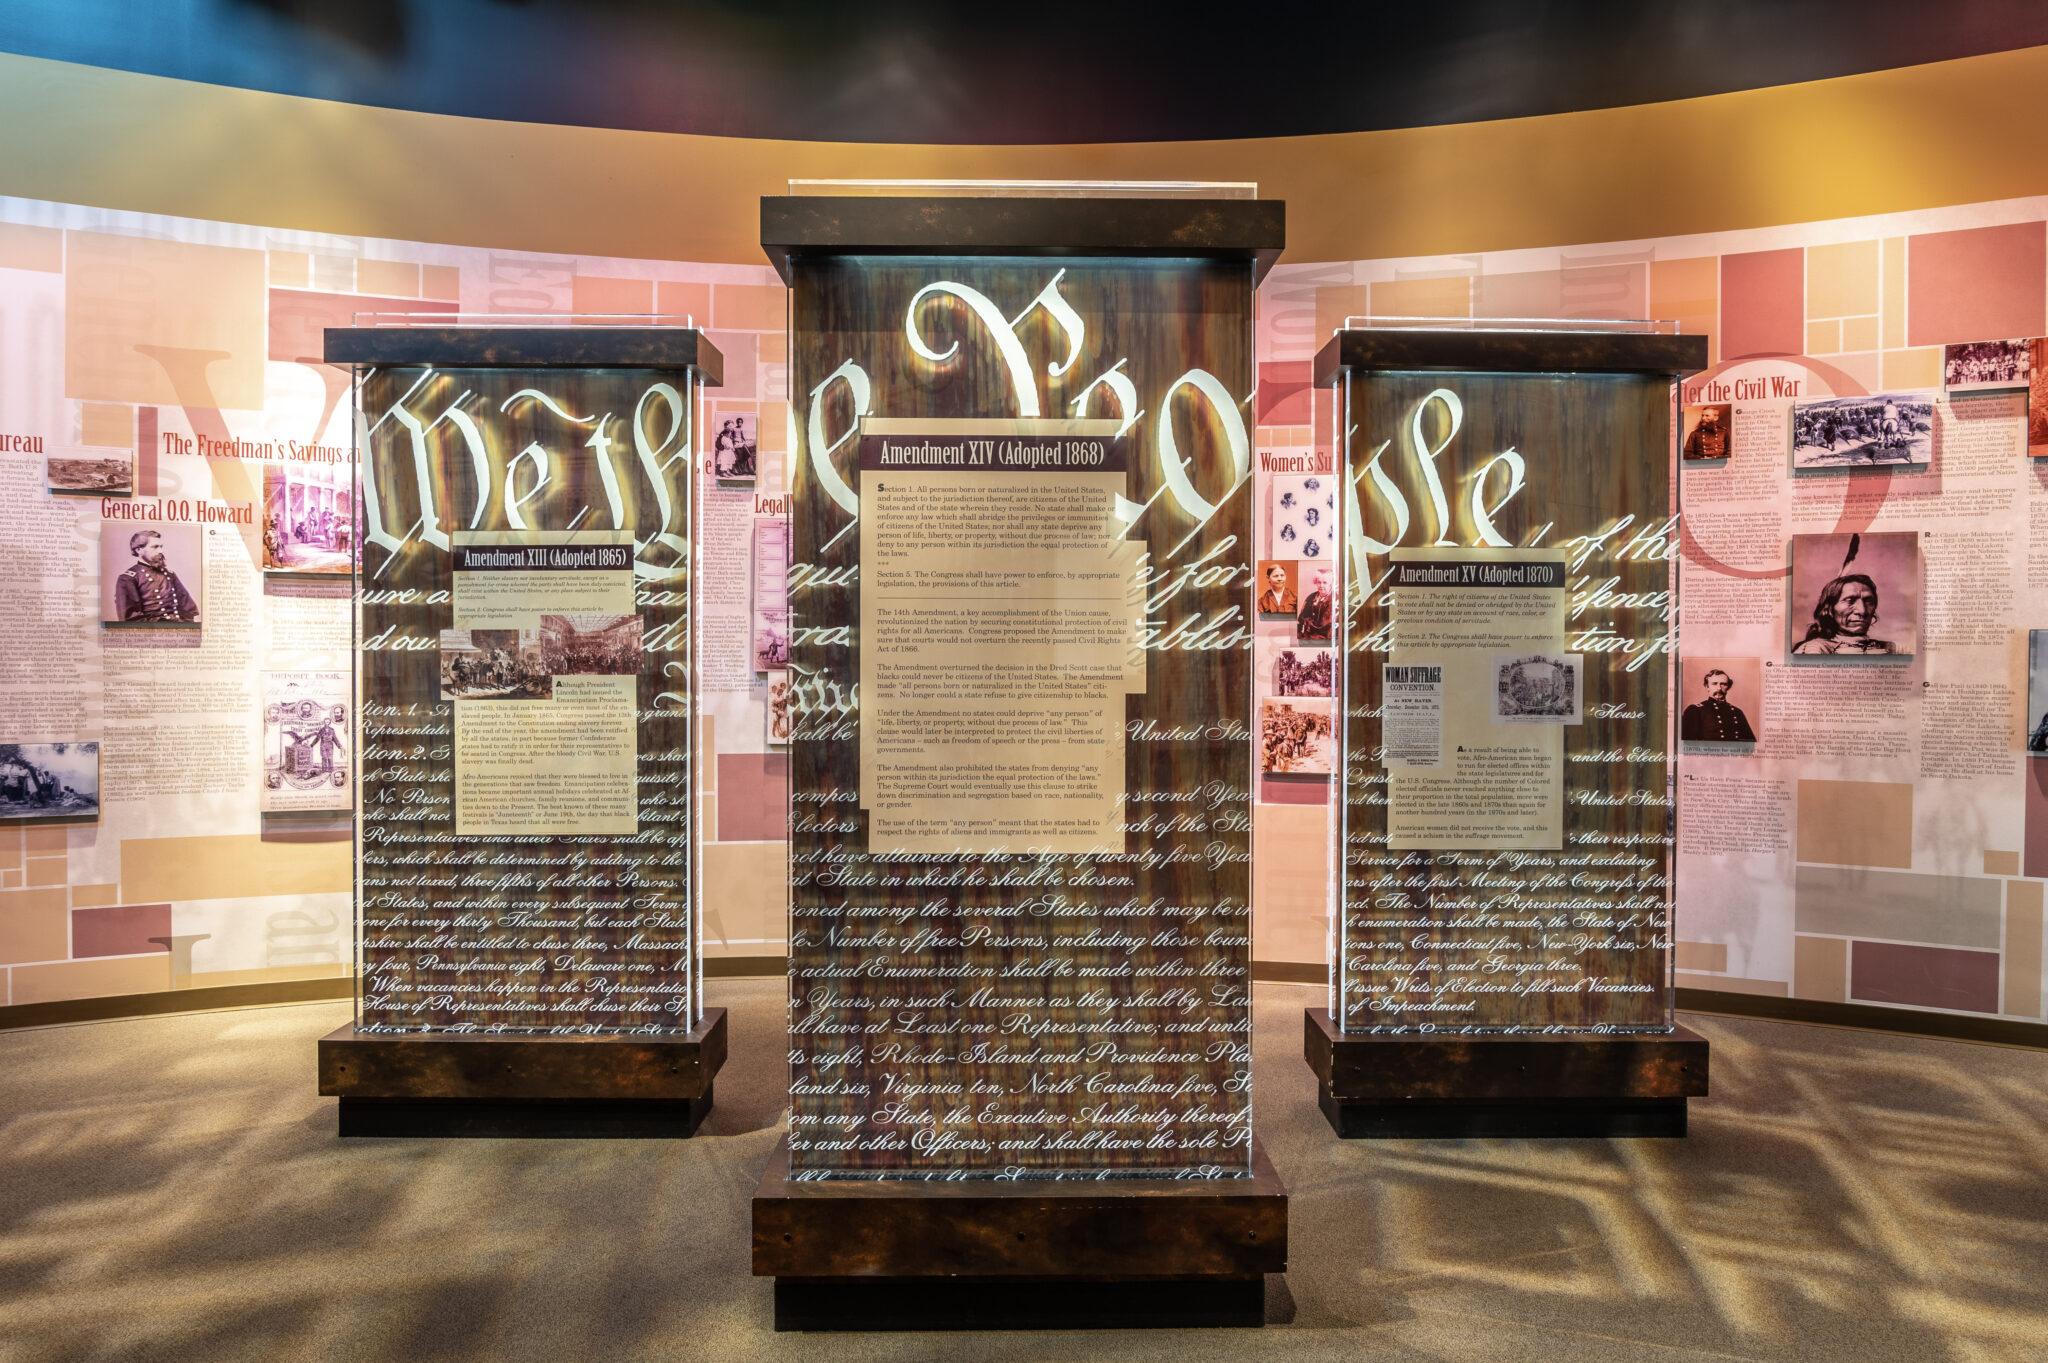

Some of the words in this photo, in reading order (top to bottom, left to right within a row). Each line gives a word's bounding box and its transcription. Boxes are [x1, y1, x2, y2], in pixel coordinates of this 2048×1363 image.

[1708, 381, 1730, 401] the
[1735, 377, 1766, 400] Civil
[1771, 376, 1800, 398] War
[163, 432, 193, 455] The
[198, 433, 285, 459] Freedman's
[289, 439, 342, 464] Savings
[880, 441, 965, 464] Amendment
[968, 441, 995, 464] XIV
[999, 441, 1062, 468] (Adopted
[1065, 441, 1104, 465] 1868)
[1260, 452, 1314, 472] Women's
[878, 484, 906, 493] Section
[102, 497, 162, 520] General
[168, 501, 192, 522] O.O.
[196, 501, 252, 524] Howard
[755, 494, 787, 516] Legal
[464, 549, 525, 567] Amendment
[527, 549, 547, 566] XIII
[550, 549, 596, 568] (Adopted
[598, 549, 626, 566] 1865)
[931, 571, 963, 580] Congress
[1068, 572, 1076, 580] by
[1078, 572, 1120, 580] appropriate
[932, 580, 969, 589] provisions
[1400, 565, 1459, 583] Amendment
[1461, 566, 1476, 583] XV
[1479, 566, 1524, 585] (Adopted
[1526, 566, 1553, 583] 1870)
[967, 608, 979, 617] key
[982, 609, 1039, 617] accomplishment
[1385, 667, 1408, 683] WOMAN
[1410, 667, 1441, 683] SUFFRAGE
[1125, 720, 1200, 741] United
[816, 863, 878, 886] State
[880, 872, 903, 886] in
[906, 867, 967, 886] which
[961, 866, 987, 886] he
[989, 862, 1046, 886] shall
[1044, 867, 1065, 886] be
[416, 954, 508, 976] Pennsylvania
[554, 954, 626, 972] Delaware
[1347, 955, 1414, 971] Carolina
[1447, 959, 1480, 971] and
[1482, 954, 1544, 976] Georgia
[1354, 983, 1389, 993] issue
[1391, 977, 1432, 993] Writs
[1434, 979, 1455, 997] of
[1451, 977, 1507, 993] Election
[1510, 982, 1525, 993] to
[1521, 978, 1553, 997] fill
[1550, 978, 1585, 993] such
[363, 994, 410, 1011] House
[412, 996, 432, 1015] of
[430, 994, 549, 1014] Representatives
[550, 997, 595, 1012] shall
[590, 998, 628, 1012] chuse
[629, 998, 661, 1012] their
[879, 996, 900, 1008] in
[904, 989, 955, 1008] such
[950, 986, 1048, 1008] Manner
[1050, 995, 1074, 1007] as
[1077, 988, 1124, 1015] they
[1122, 988, 1184, 1007] shall
[1177, 988, 1203, 1015] by
[1348, 997, 1370, 1015] of
[1039, 1047, 1086, 1063] and
[1086, 1040, 1201, 1063] Providence
[879, 1072, 964, 1102] Virginia
[1010, 1072, 1083, 1094] North
[1083, 1072, 1177, 1094] Carolina
